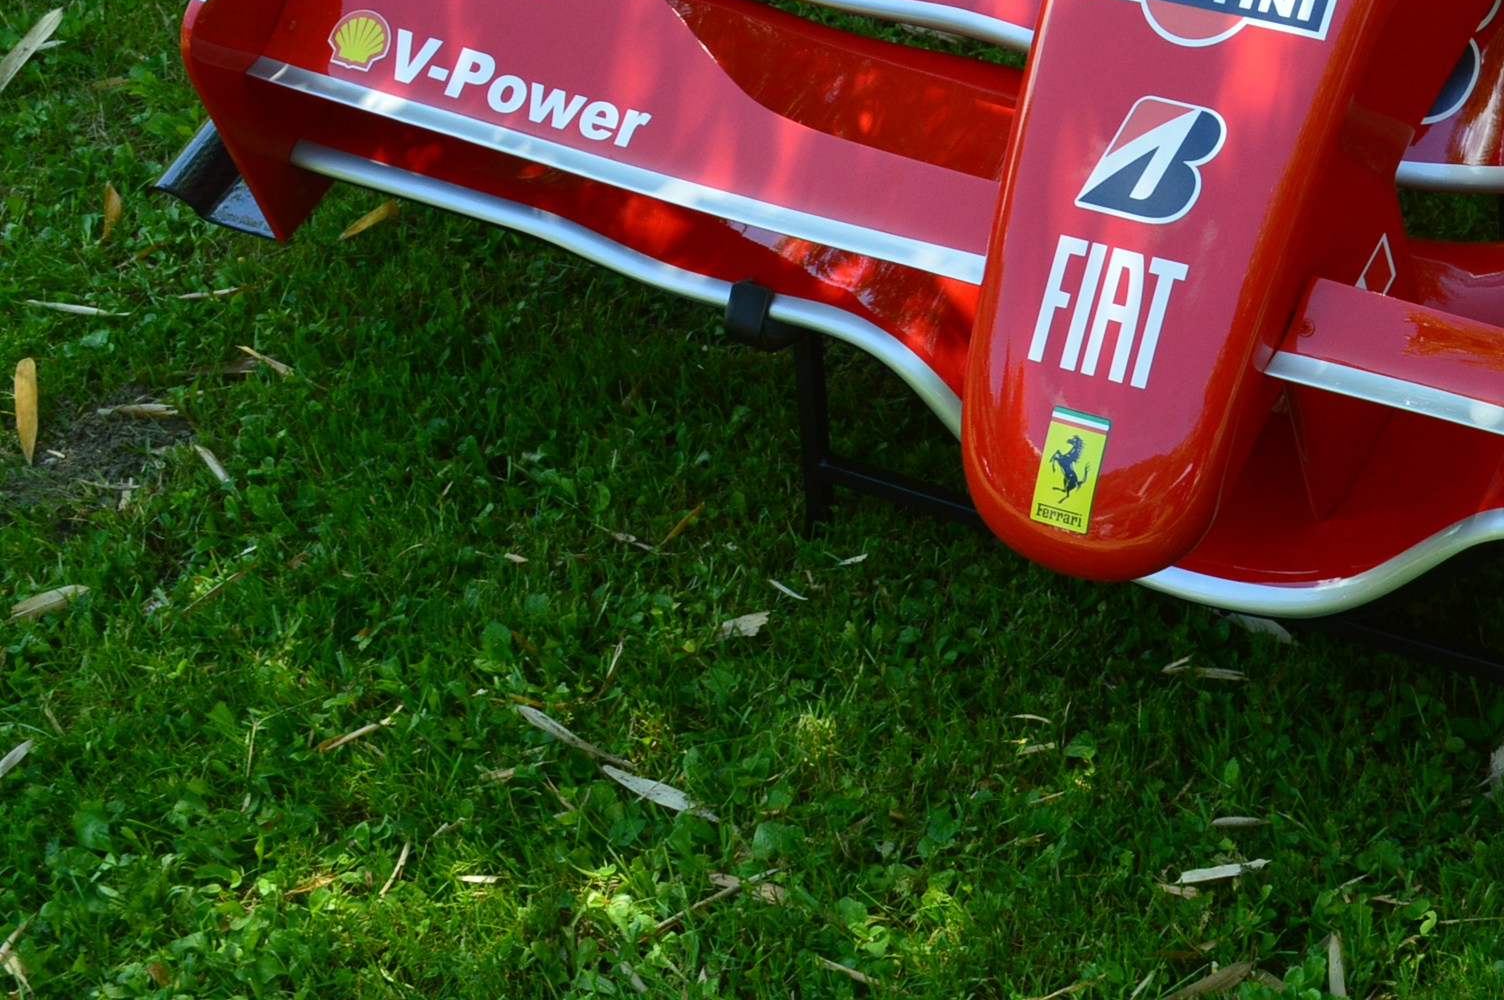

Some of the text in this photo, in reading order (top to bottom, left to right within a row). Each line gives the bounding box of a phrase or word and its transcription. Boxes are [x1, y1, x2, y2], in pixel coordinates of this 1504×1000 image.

[393, 28, 652, 148] V-Power
[1027, 234, 1189, 389] FIAT
[1036, 502, 1083, 528] Ferrari
